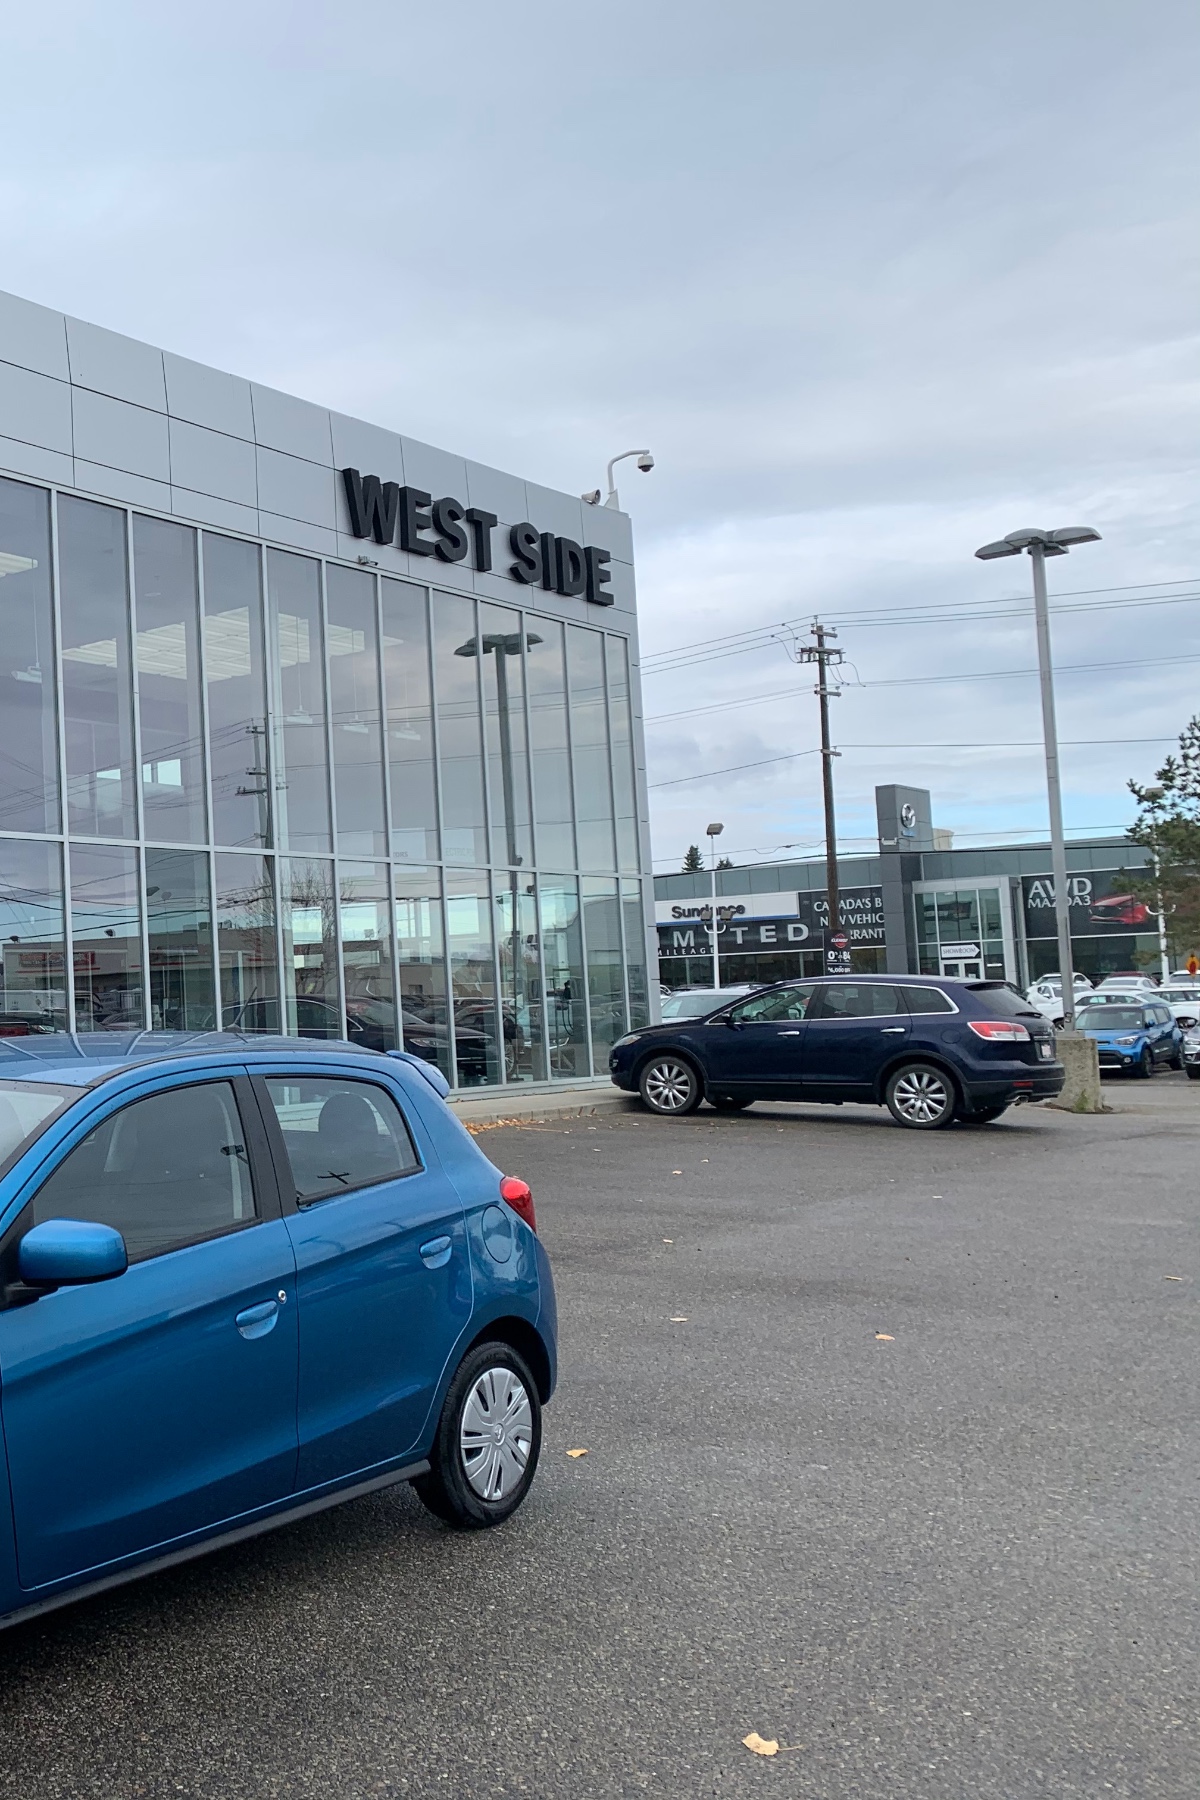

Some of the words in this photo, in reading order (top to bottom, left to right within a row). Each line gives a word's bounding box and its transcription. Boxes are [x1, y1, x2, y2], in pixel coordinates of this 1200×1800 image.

[342, 467, 498, 572] WEST
[509, 522, 614, 606] SIDE
[813, 897, 872, 912] CAADA'S
